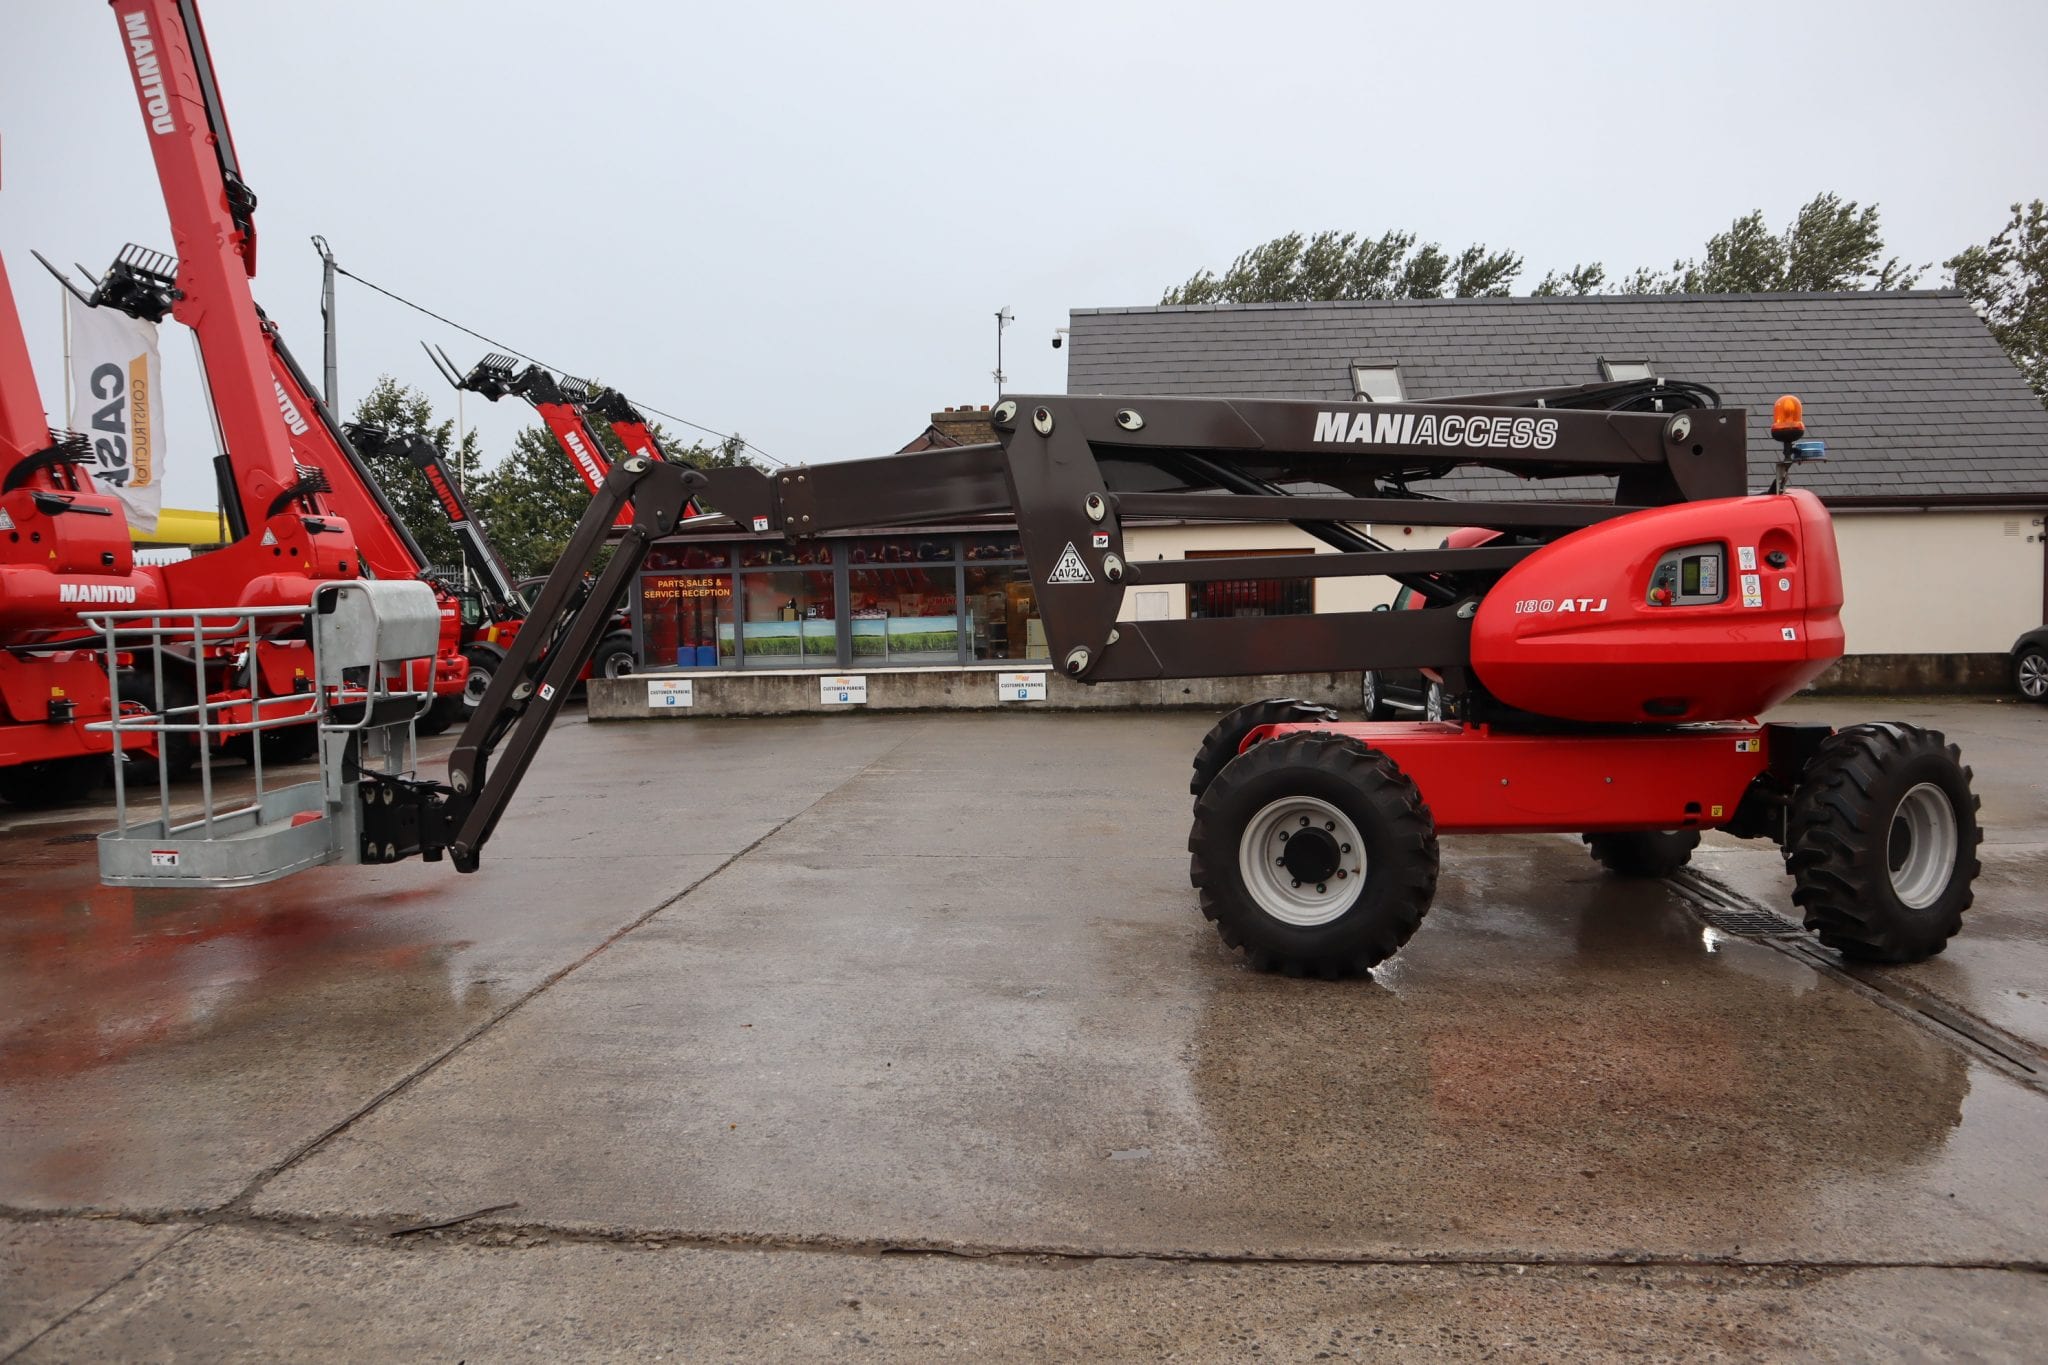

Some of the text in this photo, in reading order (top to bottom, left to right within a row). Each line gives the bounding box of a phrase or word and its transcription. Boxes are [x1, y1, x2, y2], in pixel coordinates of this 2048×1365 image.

[124, 11, 175, 135] MANITOU
[1313, 411, 1559, 449] MANIACCESS
[564, 431, 605, 488] MANITOU
[424, 464, 464, 521] MANITOU
[1065, 558, 1077, 568] 19
[716, 578, 722, 586] &
[60, 583, 136, 603] MANITOU
[644, 588, 730, 599] SERVICE RECEPTION
[1515, 598, 1608, 614] 180 ATJ
